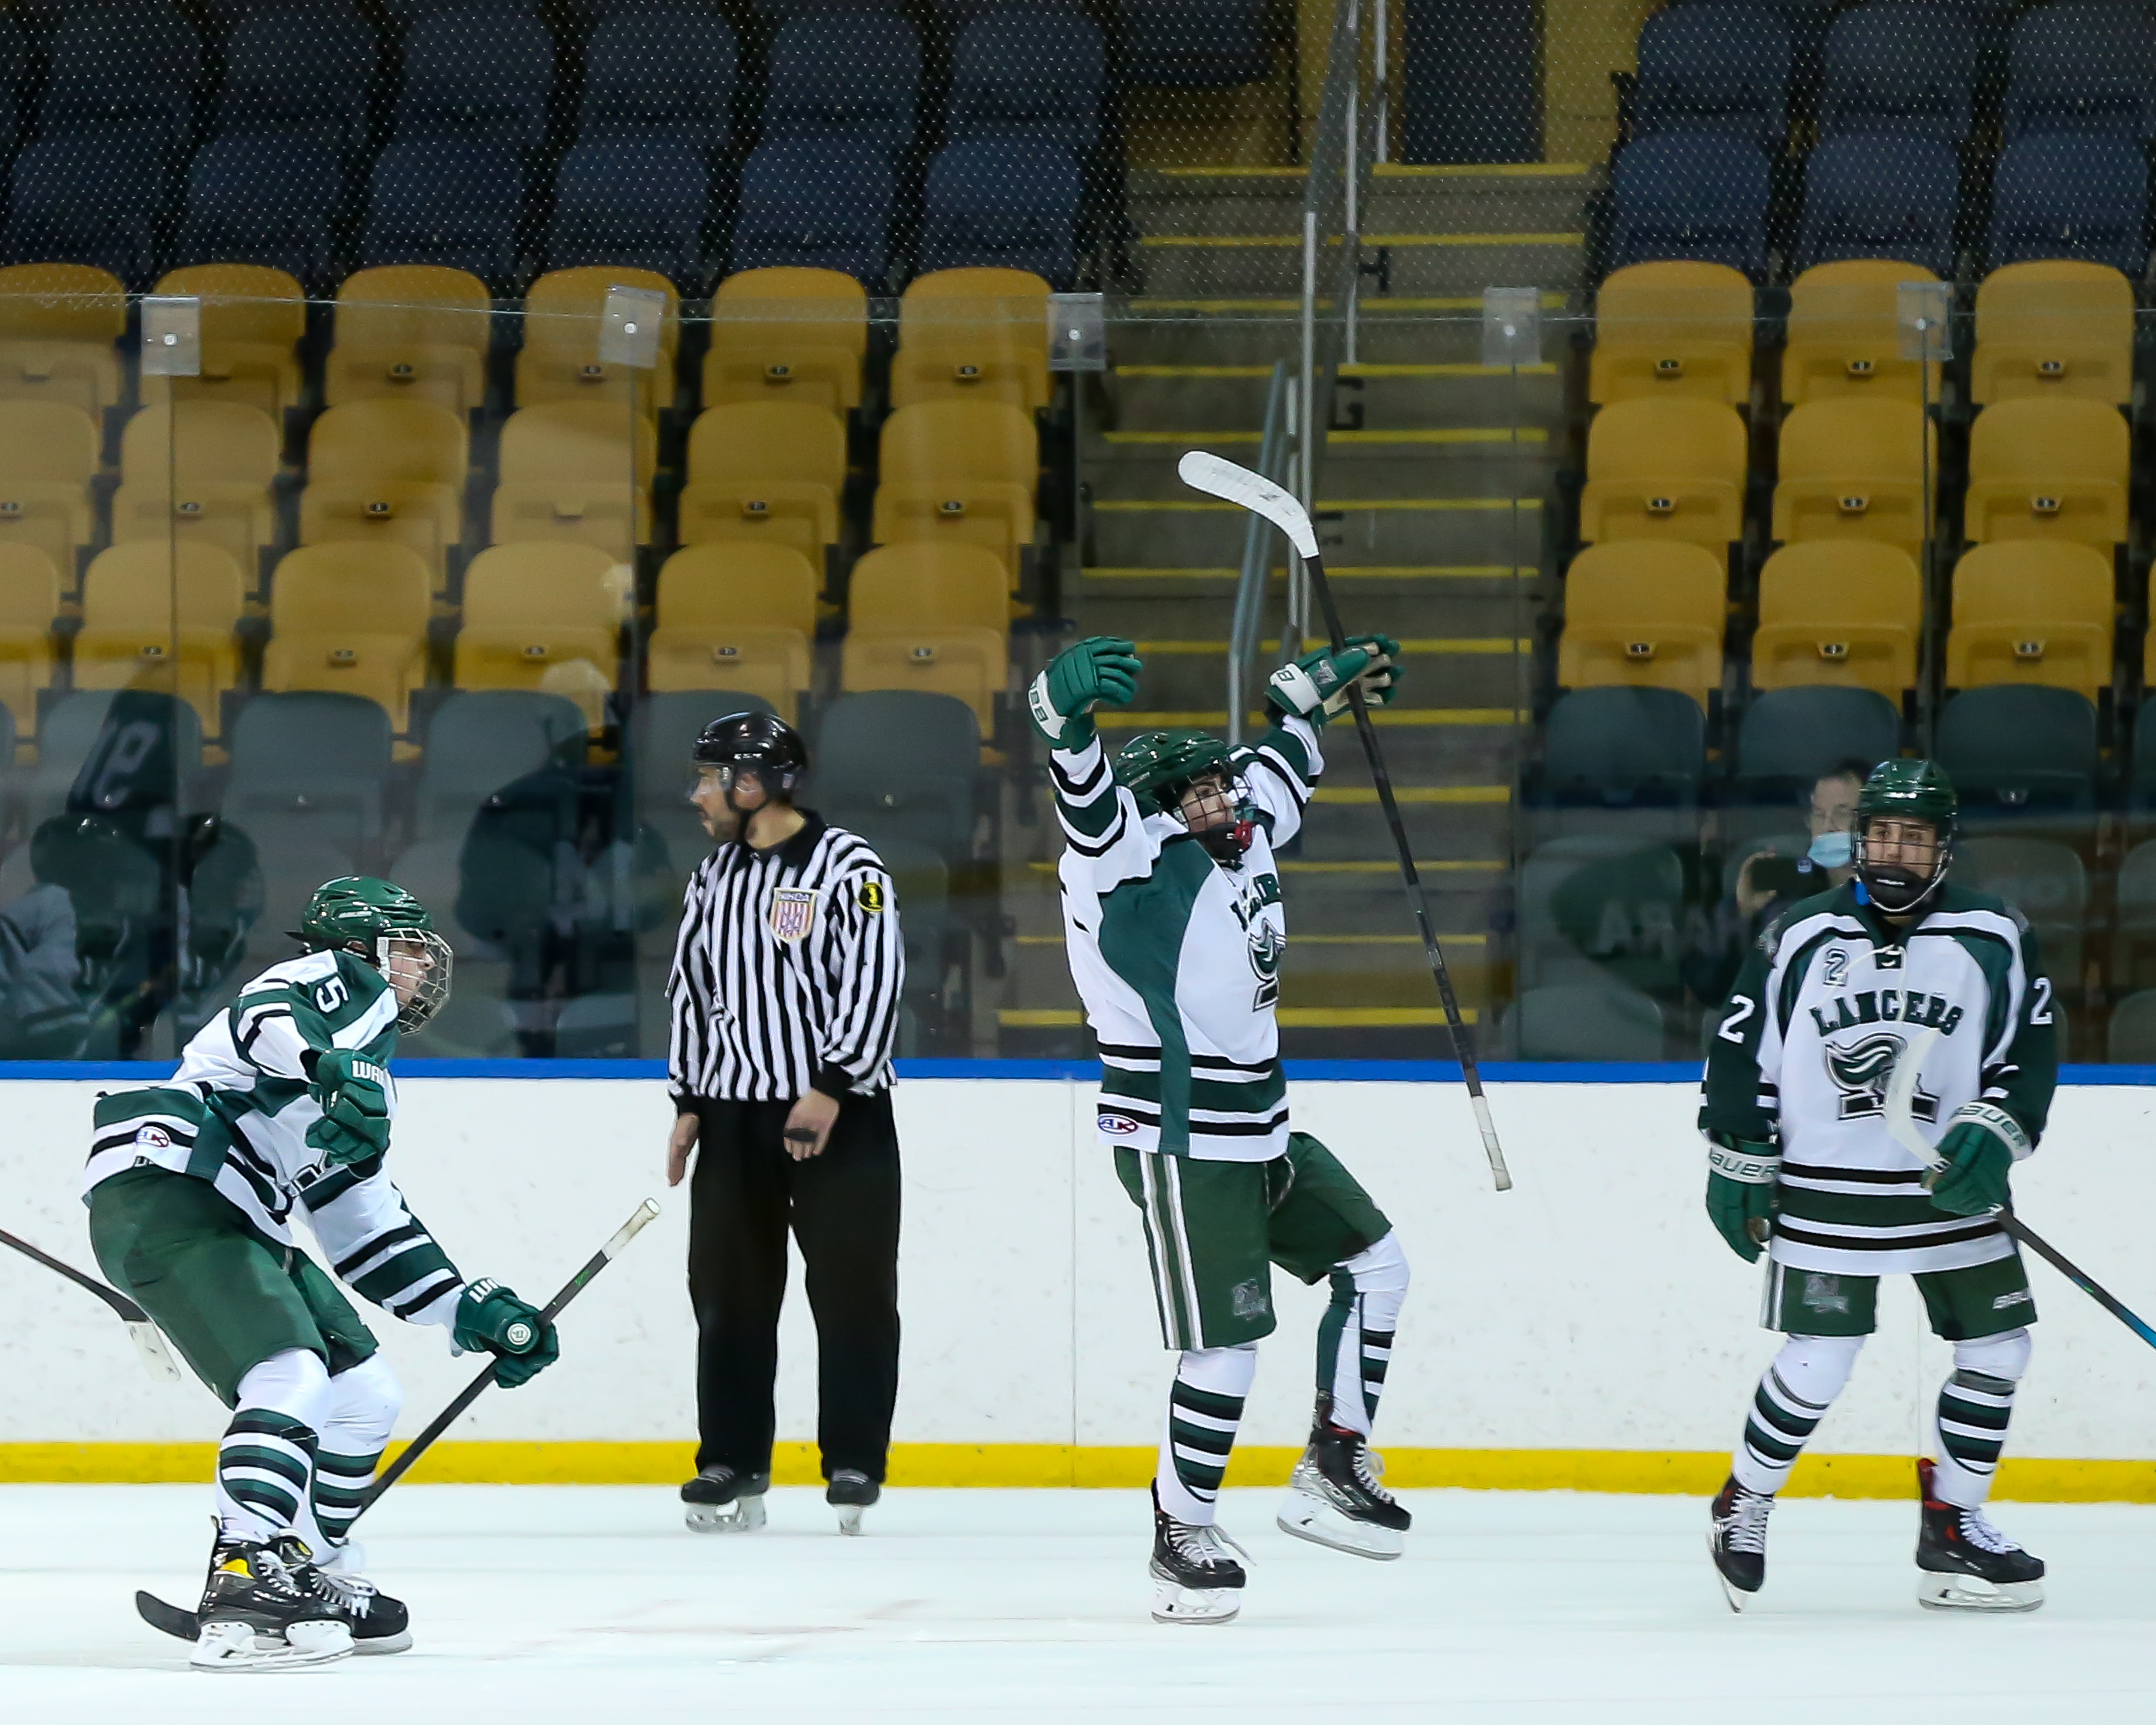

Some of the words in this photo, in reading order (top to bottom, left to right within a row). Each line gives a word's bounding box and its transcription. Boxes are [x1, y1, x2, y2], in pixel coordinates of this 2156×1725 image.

[1824, 948, 1849, 986] 2
[316, 976, 349, 1013] 5
[2030, 977, 2053, 1025] 2
[1717, 994, 1755, 1044] 2
